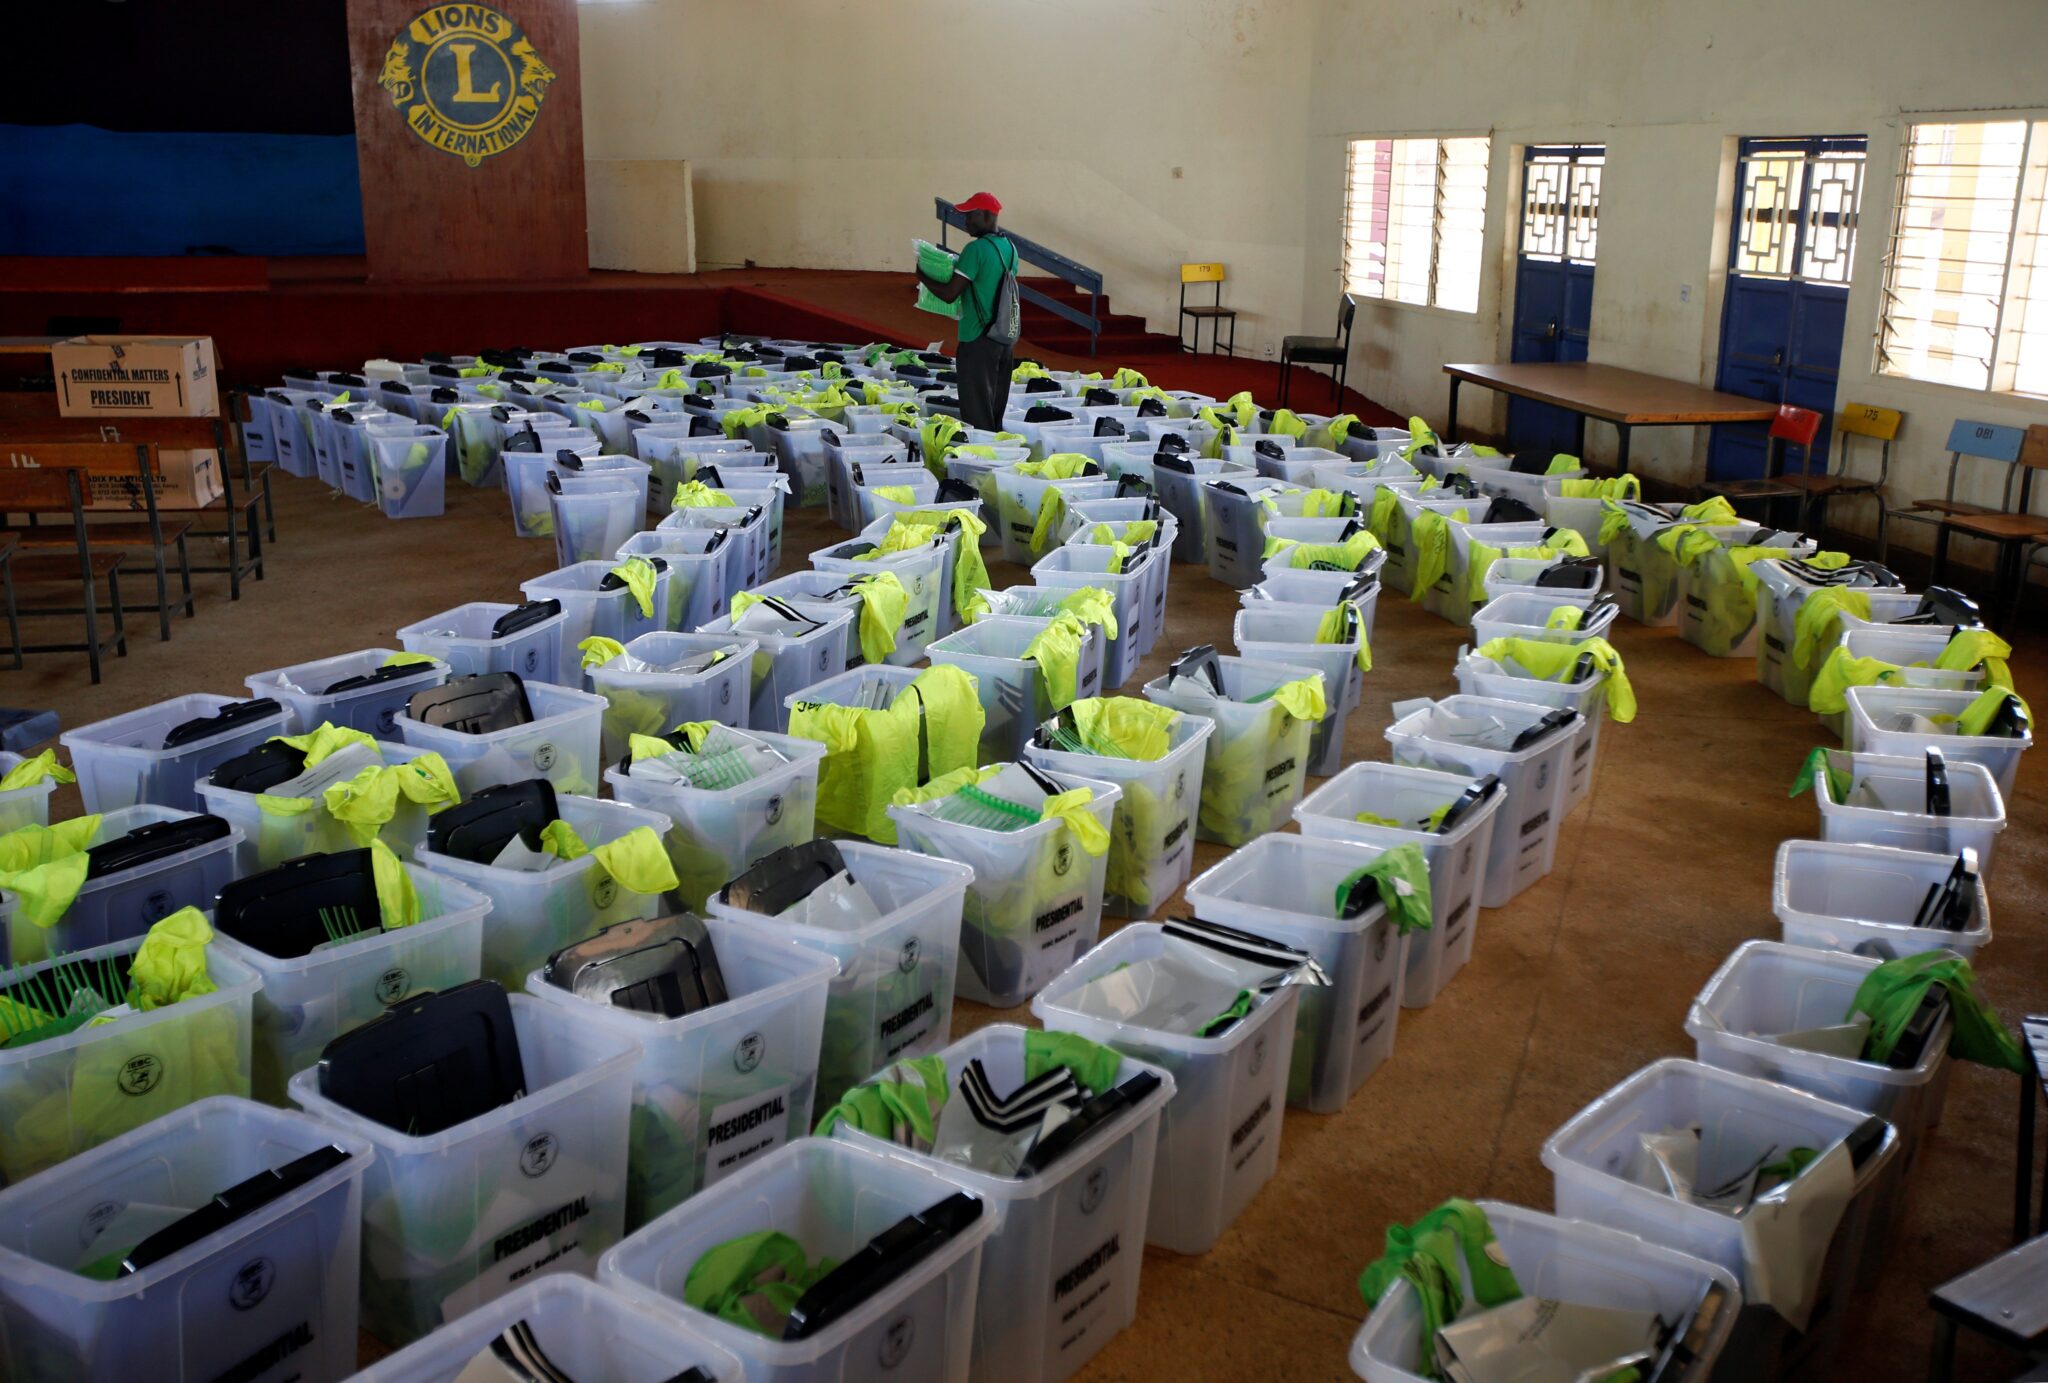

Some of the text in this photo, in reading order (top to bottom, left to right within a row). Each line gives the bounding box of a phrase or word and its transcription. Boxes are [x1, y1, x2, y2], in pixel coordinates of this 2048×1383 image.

[418, 6, 499, 38] LIONS
[449, 44, 501, 102] L
[414, 104, 536, 154] INTERNATIONAL
[71, 368, 169, 381] CONFIDENTIAL MATTERS
[90, 390, 151, 406] PRESIDENT
[1864, 409, 1878, 421] 175
[99, 426, 121, 443] 17
[1976, 427, 1994, 440] 081
[1035, 895, 1084, 934] PRESIDENTIAL
[880, 991, 934, 1040] PRESIDENTIAL
[707, 1095, 785, 1148] PRESIDENTIAL
[494, 1195, 590, 1262] PRESIDENTIAL
